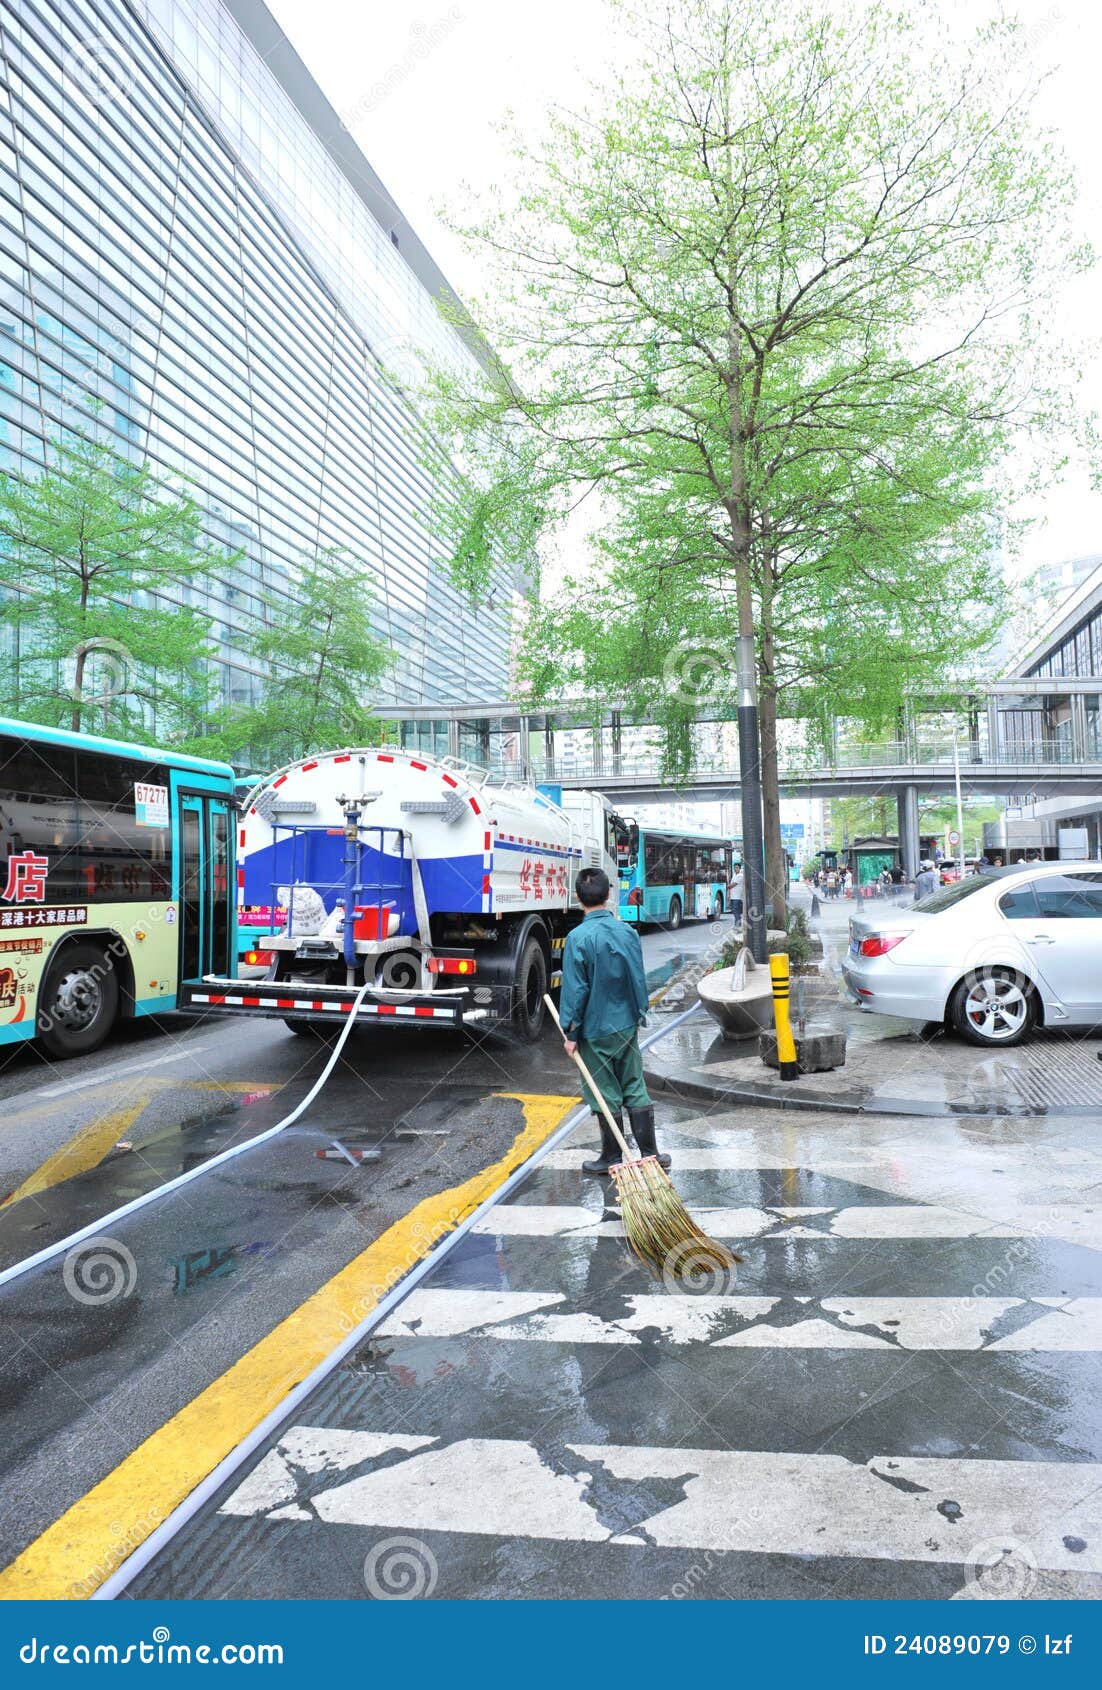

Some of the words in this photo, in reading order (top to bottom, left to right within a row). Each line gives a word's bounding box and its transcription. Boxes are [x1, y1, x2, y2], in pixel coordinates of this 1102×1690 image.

[136, 785, 167, 805] 67277
[1, 850, 48, 902] 店
[1, 909, 86, 926] 深港十大家居品牌
[0, 981, 16, 998] 庆
